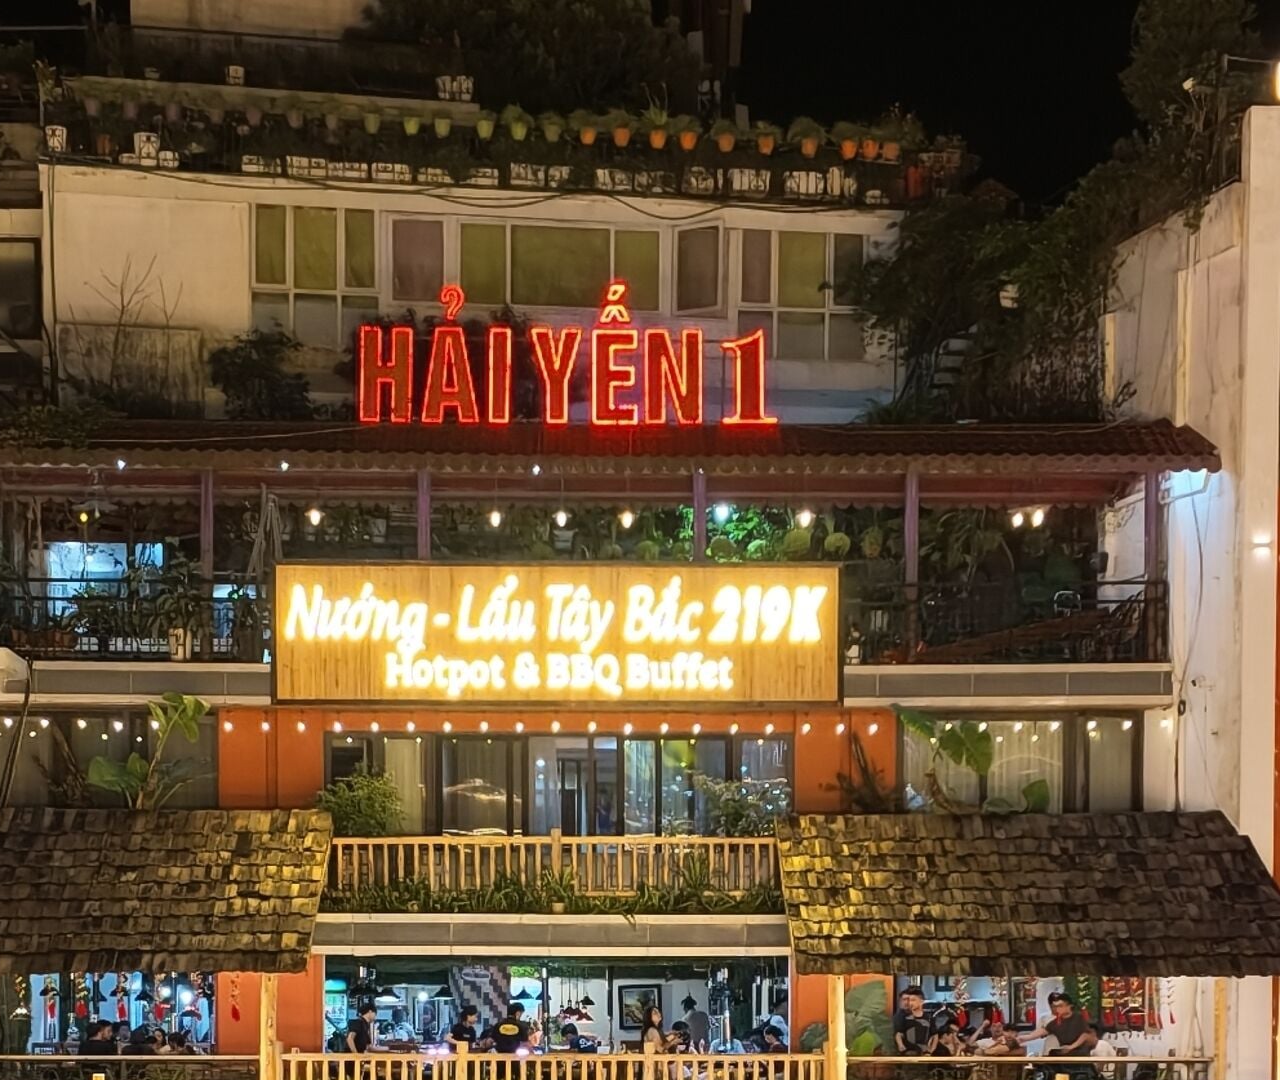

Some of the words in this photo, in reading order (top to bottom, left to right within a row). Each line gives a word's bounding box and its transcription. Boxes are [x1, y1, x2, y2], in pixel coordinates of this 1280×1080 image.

[359, 284, 511, 424] HẢI
[531, 281, 703, 425] YẾN
[721, 328, 778, 424] 1
[285, 581, 428, 651] Nướng
[709, 584, 830, 643] 219K
[385, 652, 505, 696] Hotpot
[513, 654, 540, 688] &
[545, 653, 622, 695] BBQ
[626, 653, 733, 690] Buffet
